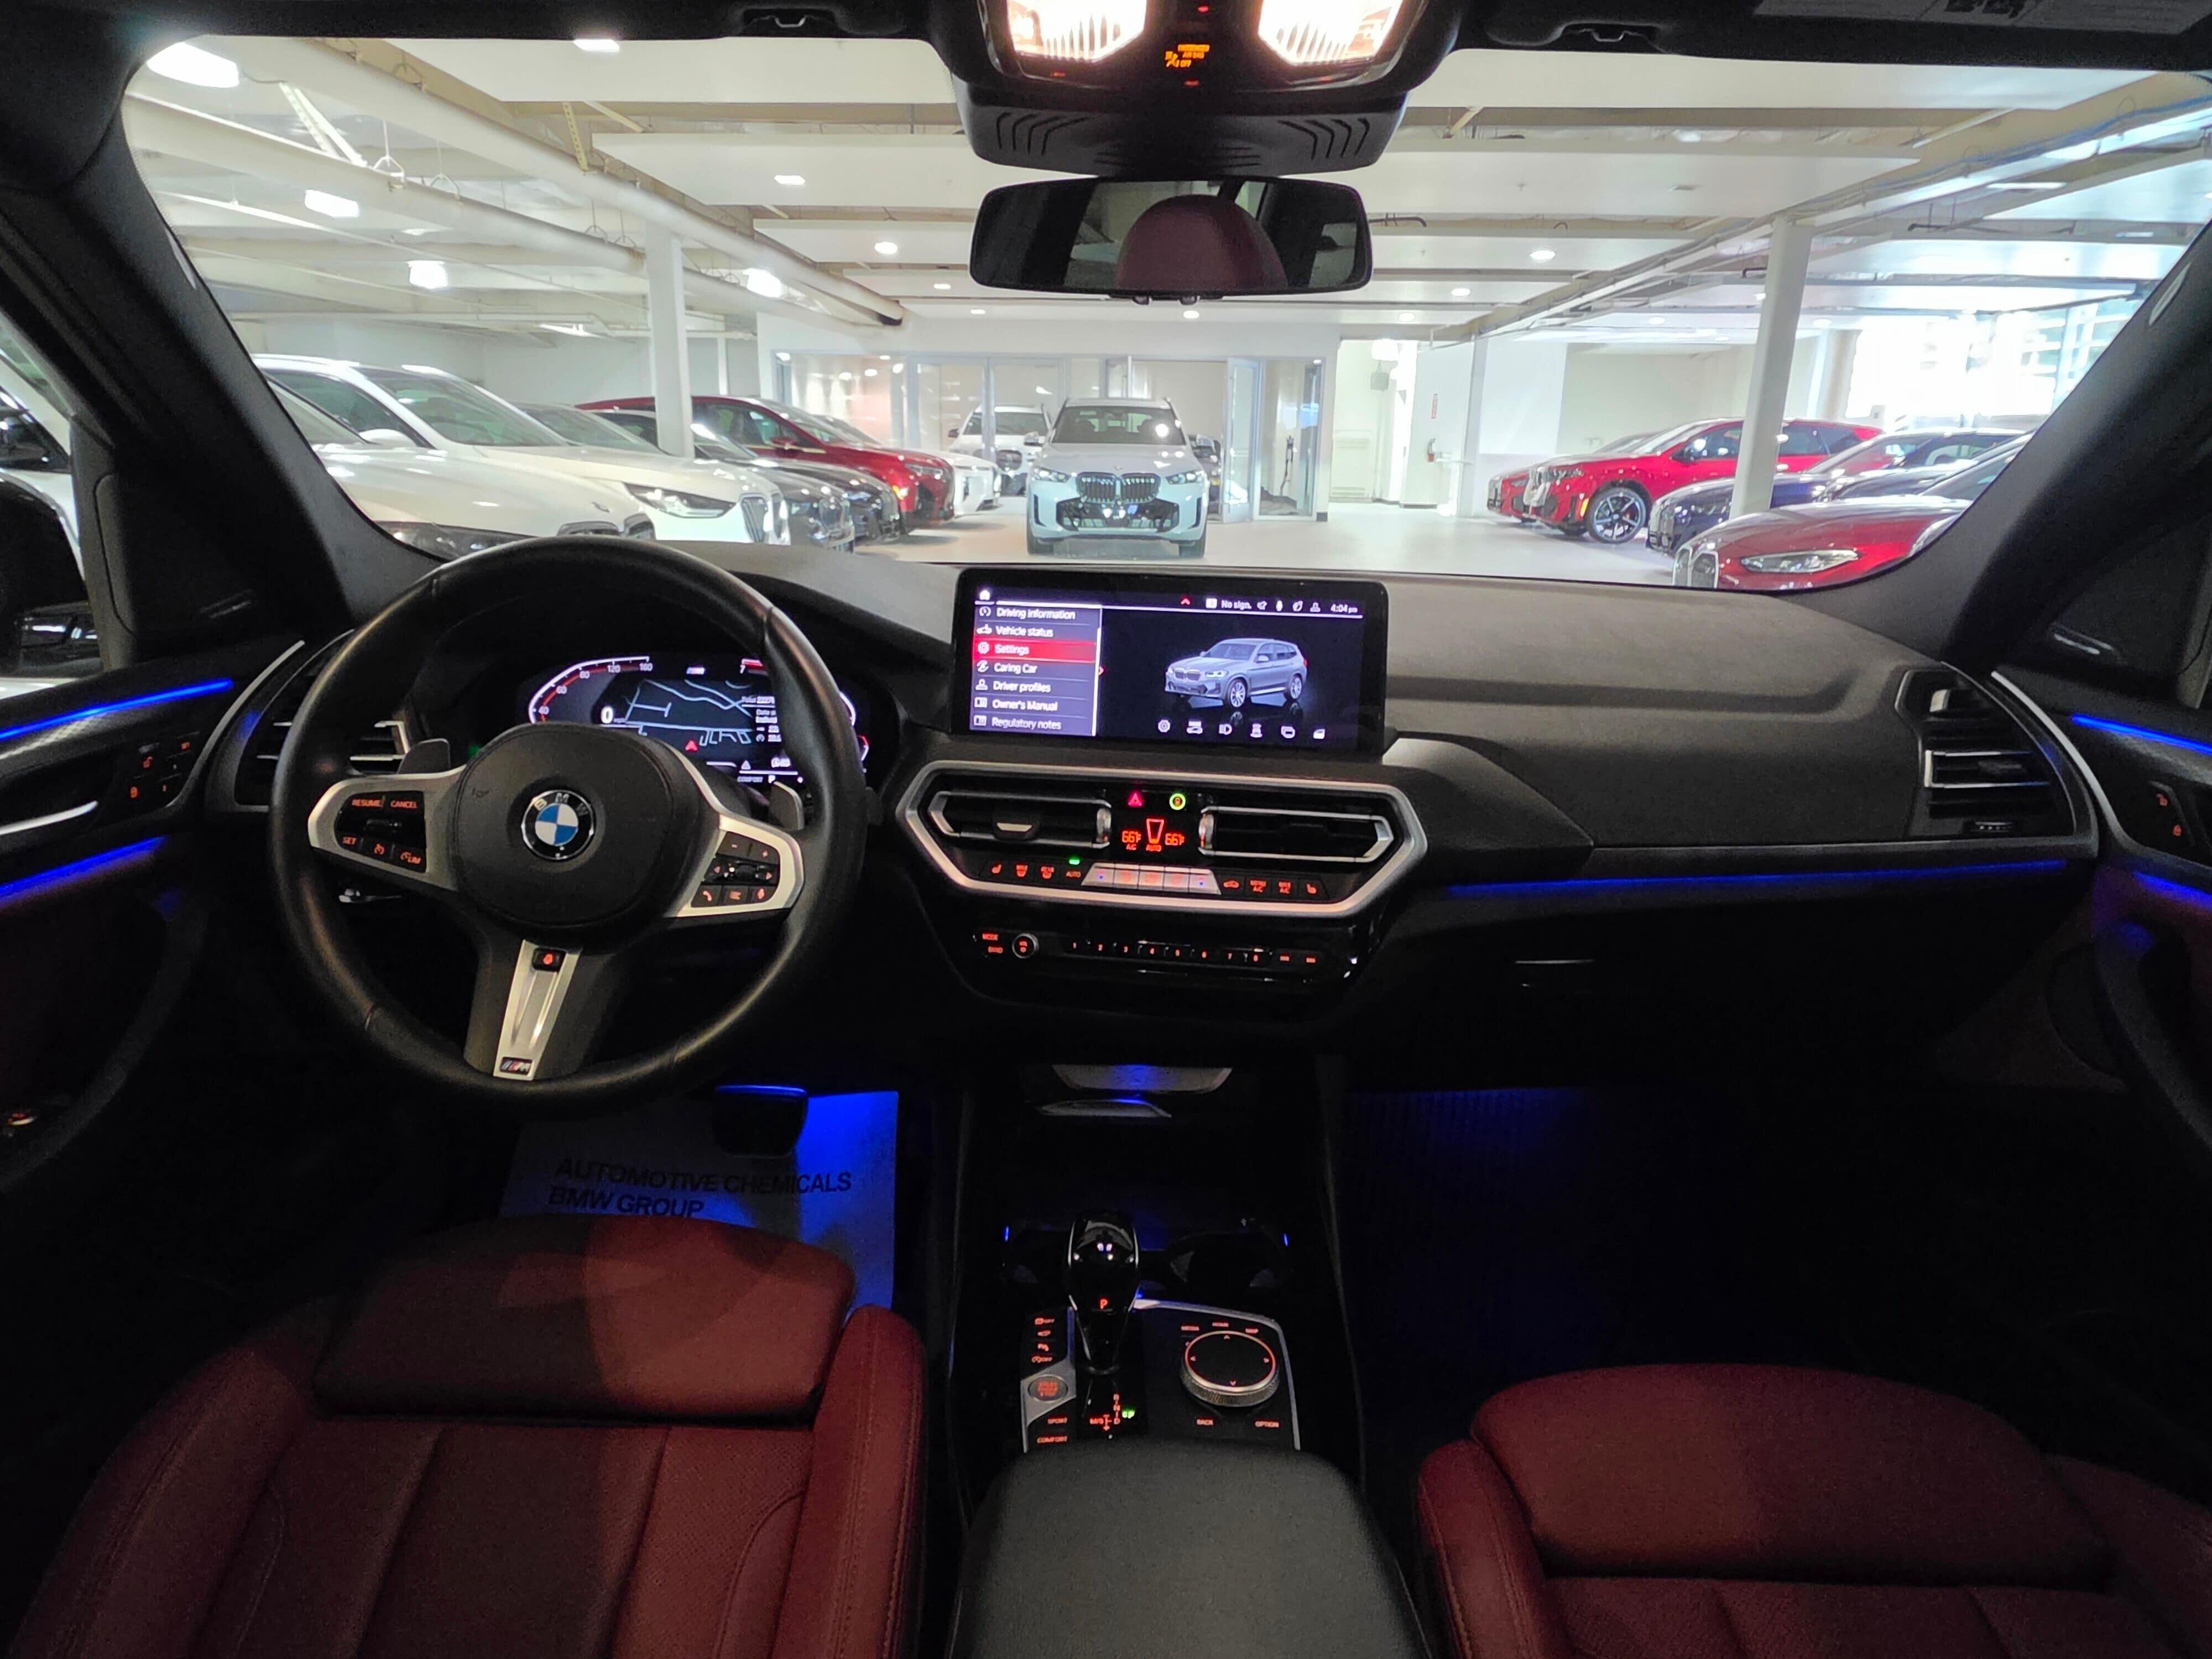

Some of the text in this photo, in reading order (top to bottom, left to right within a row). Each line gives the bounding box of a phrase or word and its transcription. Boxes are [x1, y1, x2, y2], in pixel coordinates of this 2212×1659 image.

[1221, 599, 1233, 608] No
[1331, 604, 1348, 613] 4:04
[996, 608, 1076, 620] Driving information
[995, 626, 1053, 637] Vehicle status
[994, 644, 1030, 656] Settings
[607, 664, 621, 674] 120
[994, 663, 1037, 674] Caring Car
[993, 681, 1051, 693] Driver profiles
[538, 705, 550, 715] 40
[992, 699, 1058, 711] Owner's Manual
[601, 706, 614, 724] 0
[991, 717, 1061, 729] Regulatory notes
[390, 800, 417, 808] CANCEL
[342, 837, 357, 845] SET
[554, 1158, 852, 1194] AUTOMOTIVE CHEMICALS
[547, 1186, 705, 1218] BMW GROUP
[1099, 1298, 1108, 1310] P
[1254, 1420, 1280, 1428] OPTION
[1036, 1436, 1068, 1444] COMFORT
